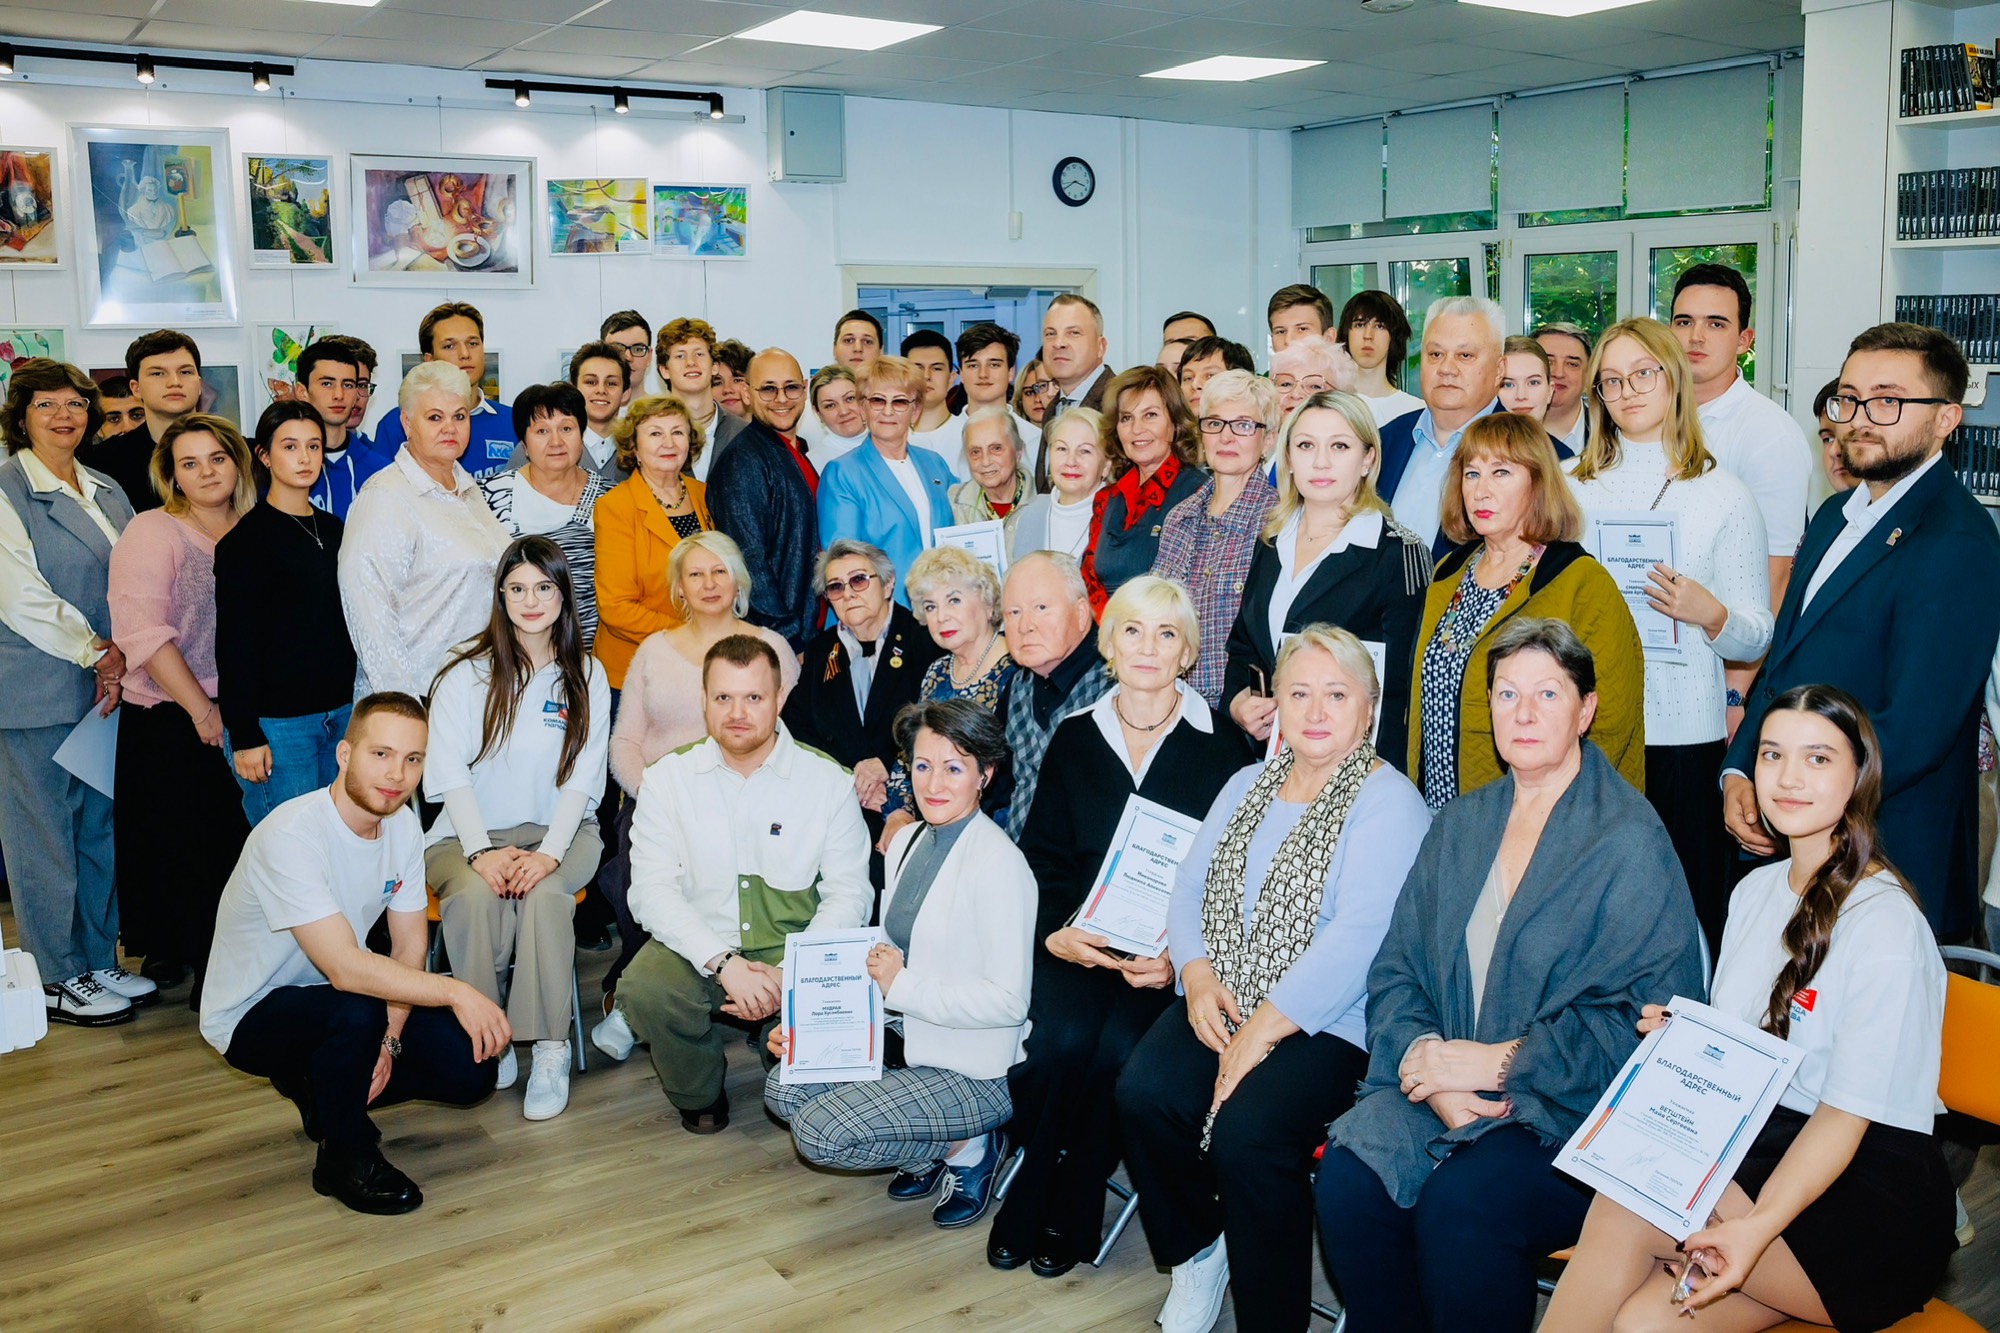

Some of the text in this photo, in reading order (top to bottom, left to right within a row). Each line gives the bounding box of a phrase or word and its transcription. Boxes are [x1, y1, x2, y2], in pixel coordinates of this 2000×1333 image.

[1131, 843, 1179, 866] БЛАГОДАРСТВЕН
[1149, 858, 1168, 868] АДРЕС
[800, 974, 863, 984] БЛАГОДАРСТВЕННЫЙ
[1656, 1057, 1742, 1103] БЛАГОДАРСТВЕННЫЙ
[1680, 1078, 1708, 1096] АДРЕС
[1649, 1106, 1699, 1136] Майя Сергеевна
[1659, 1105, 1695, 1126] ВЕТШТЕЙН
